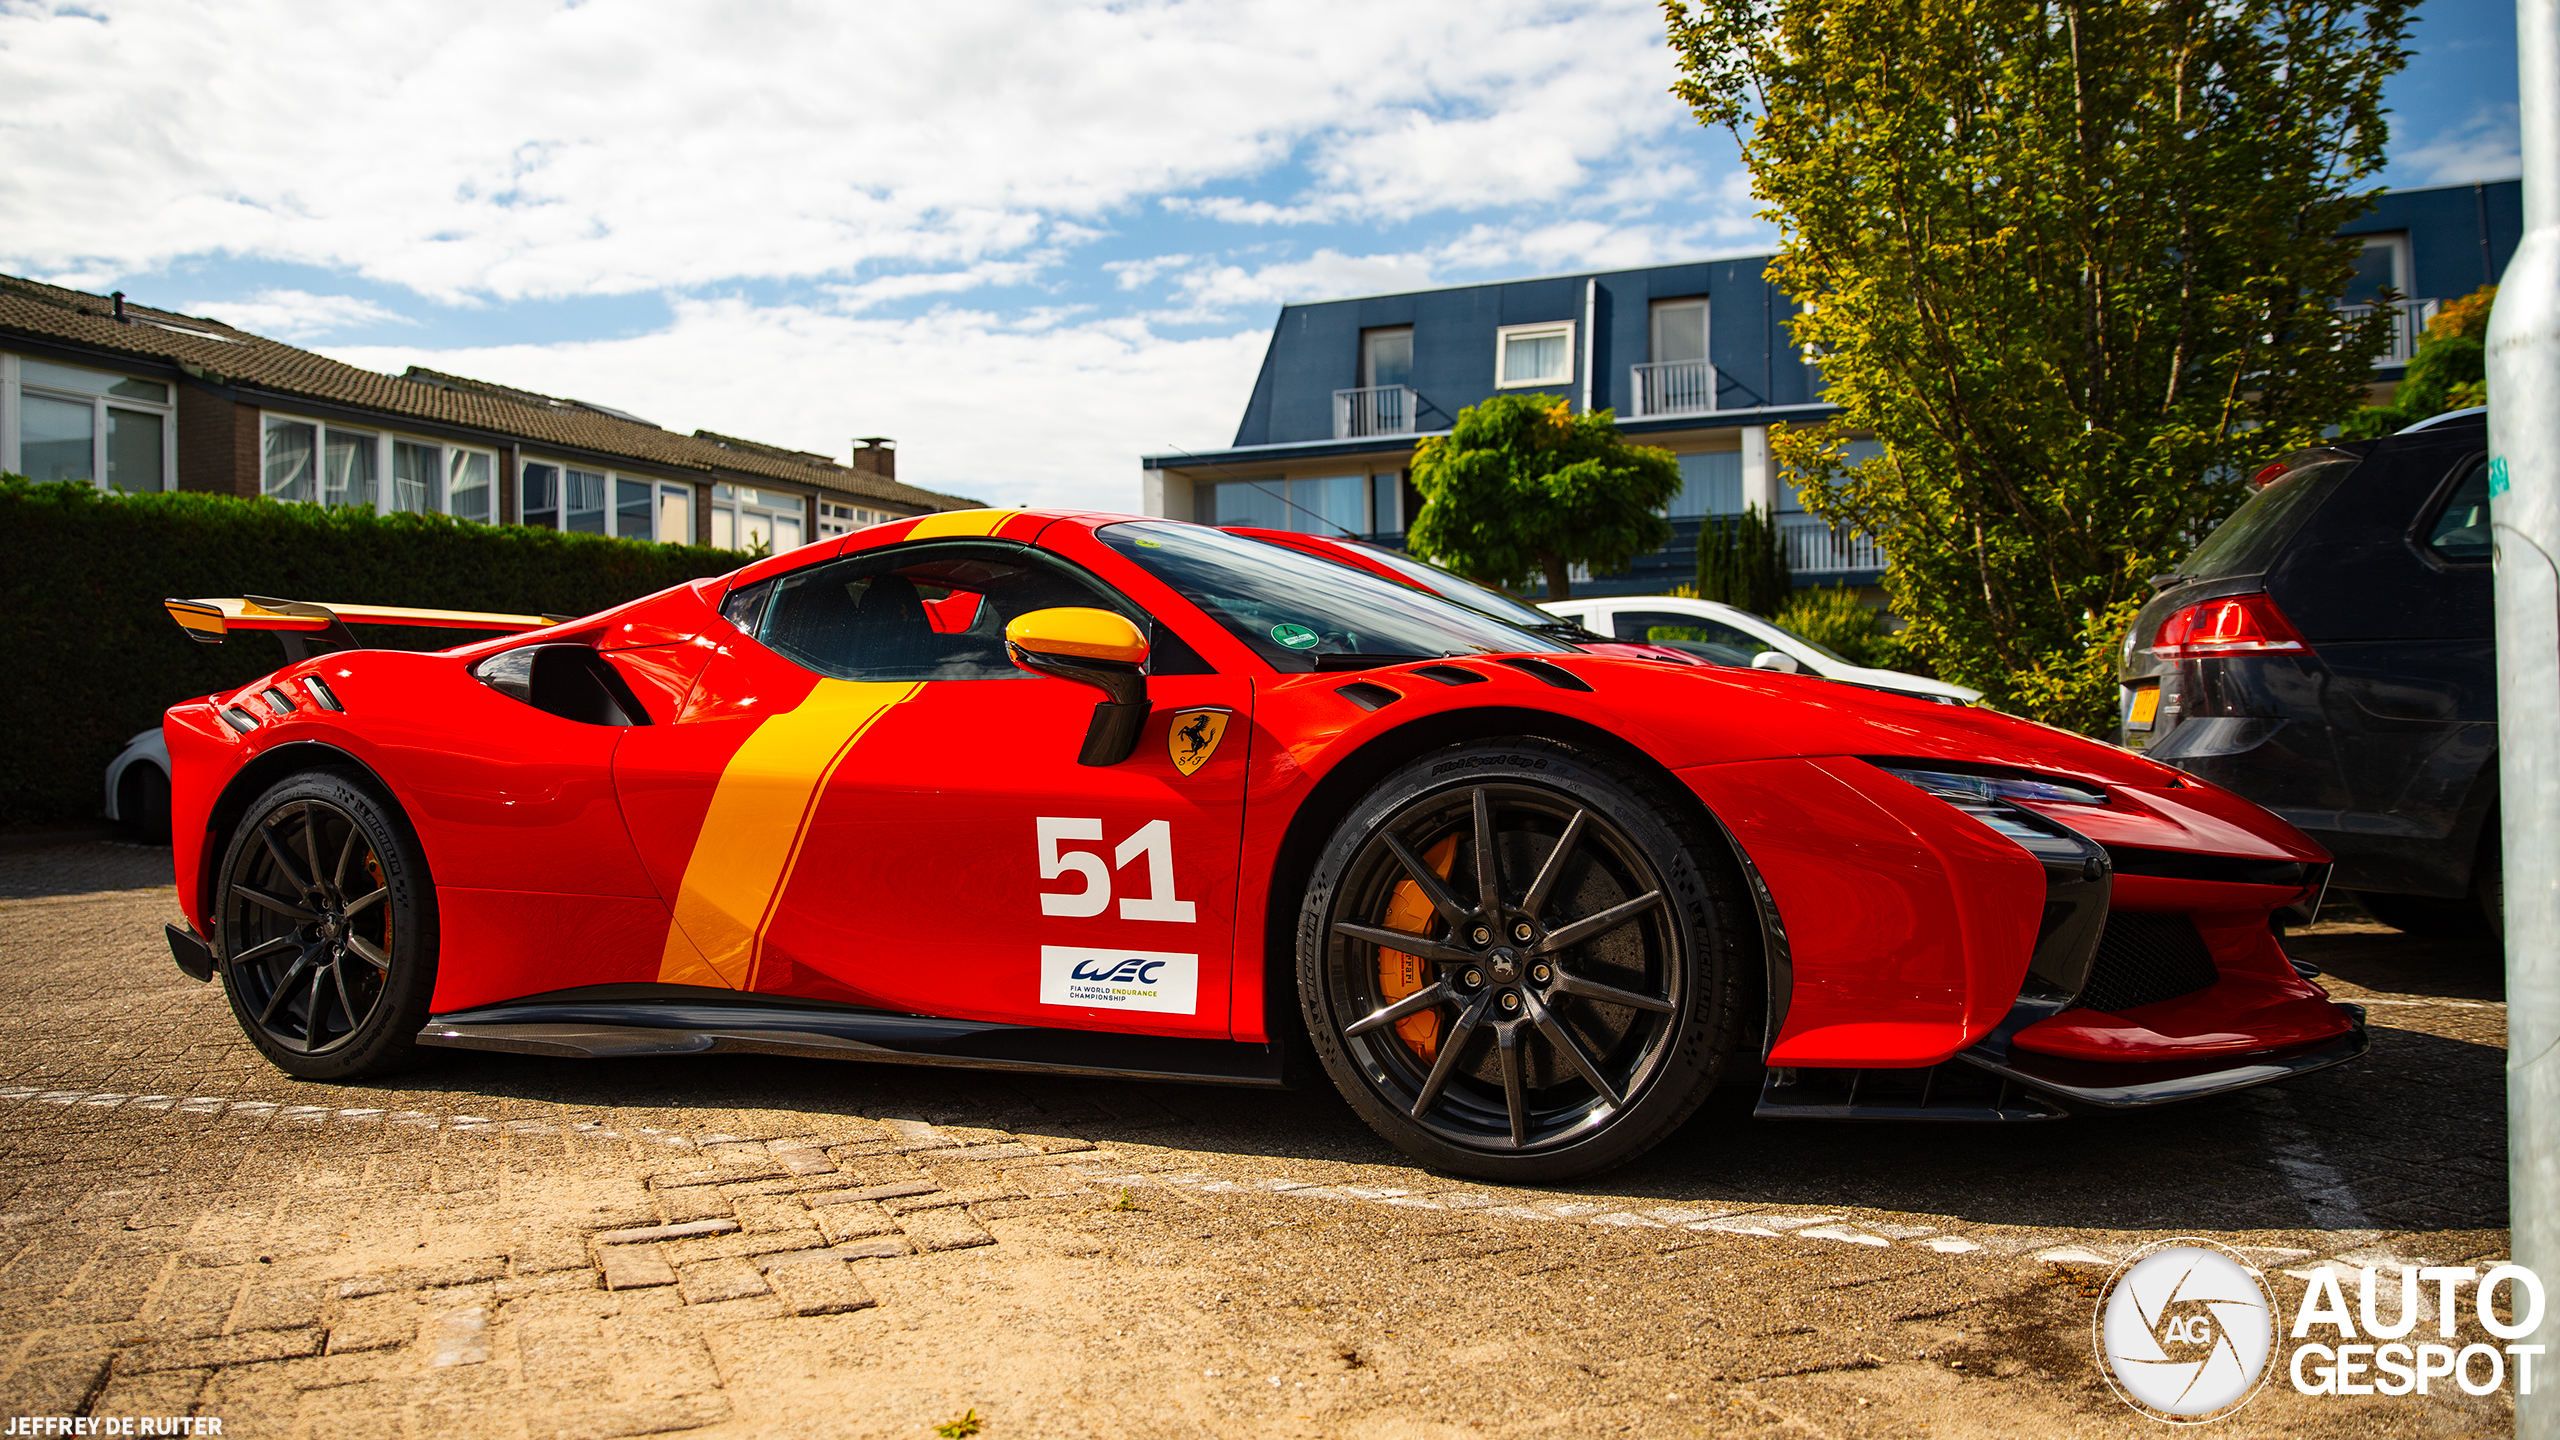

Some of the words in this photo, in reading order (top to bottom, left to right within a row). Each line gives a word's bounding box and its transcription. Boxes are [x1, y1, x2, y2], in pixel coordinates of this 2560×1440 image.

[1178, 756, 1186, 766] S
[1507, 755, 1534, 768] Cup
[1533, 759, 1548, 769] 2
[365, 811, 401, 875] MICHELIN
[1036, 816, 1197, 923] 51
[1305, 911, 1319, 1002] MICHELIN
[1071, 958, 1166, 984] WEC
[1695, 926, 1711, 1023] MICHELIN
[1069, 992, 1127, 1002] CHAMPIONSHIP
[1083, 986, 1111, 994] WORLD
[1112, 988, 1158, 997] ENDURANCE
